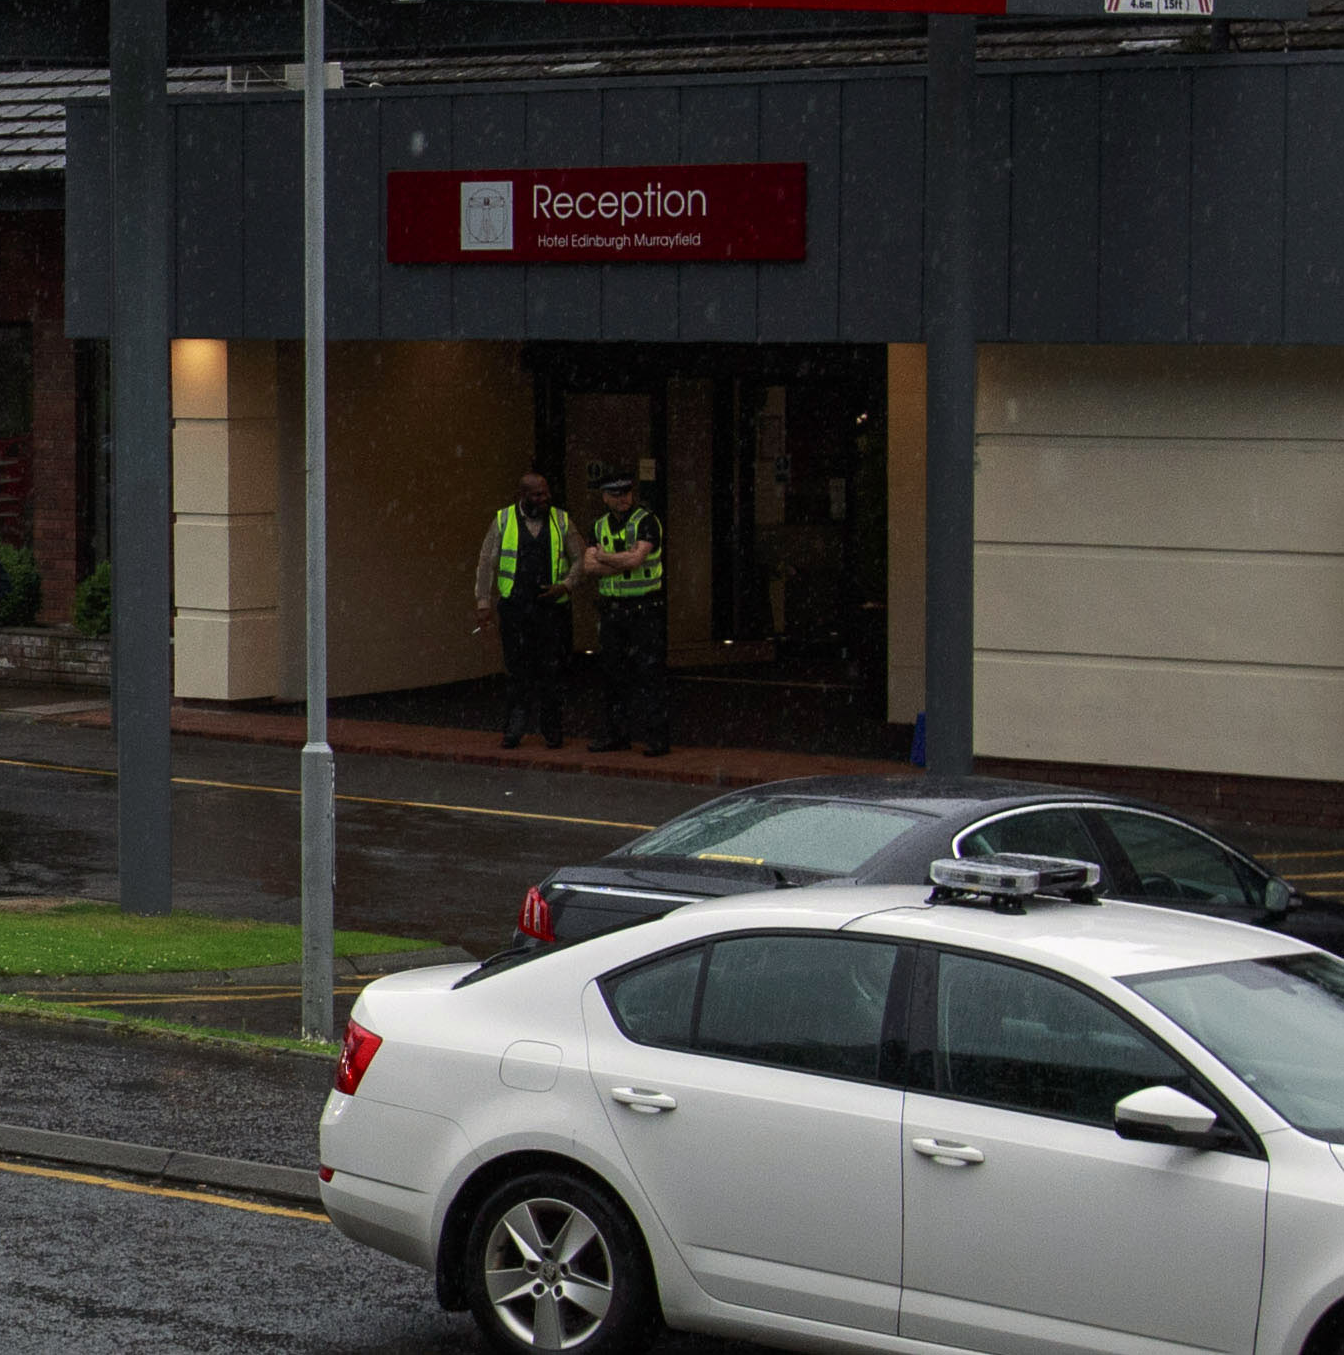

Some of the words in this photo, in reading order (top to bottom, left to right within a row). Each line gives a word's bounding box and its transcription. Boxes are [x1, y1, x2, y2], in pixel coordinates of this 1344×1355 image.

[532, 182, 707, 227] Reception
[538, 234, 569, 248] Hotel
[571, 234, 631, 251] Edinburgh
[634, 232, 701, 249] Murrayfield
